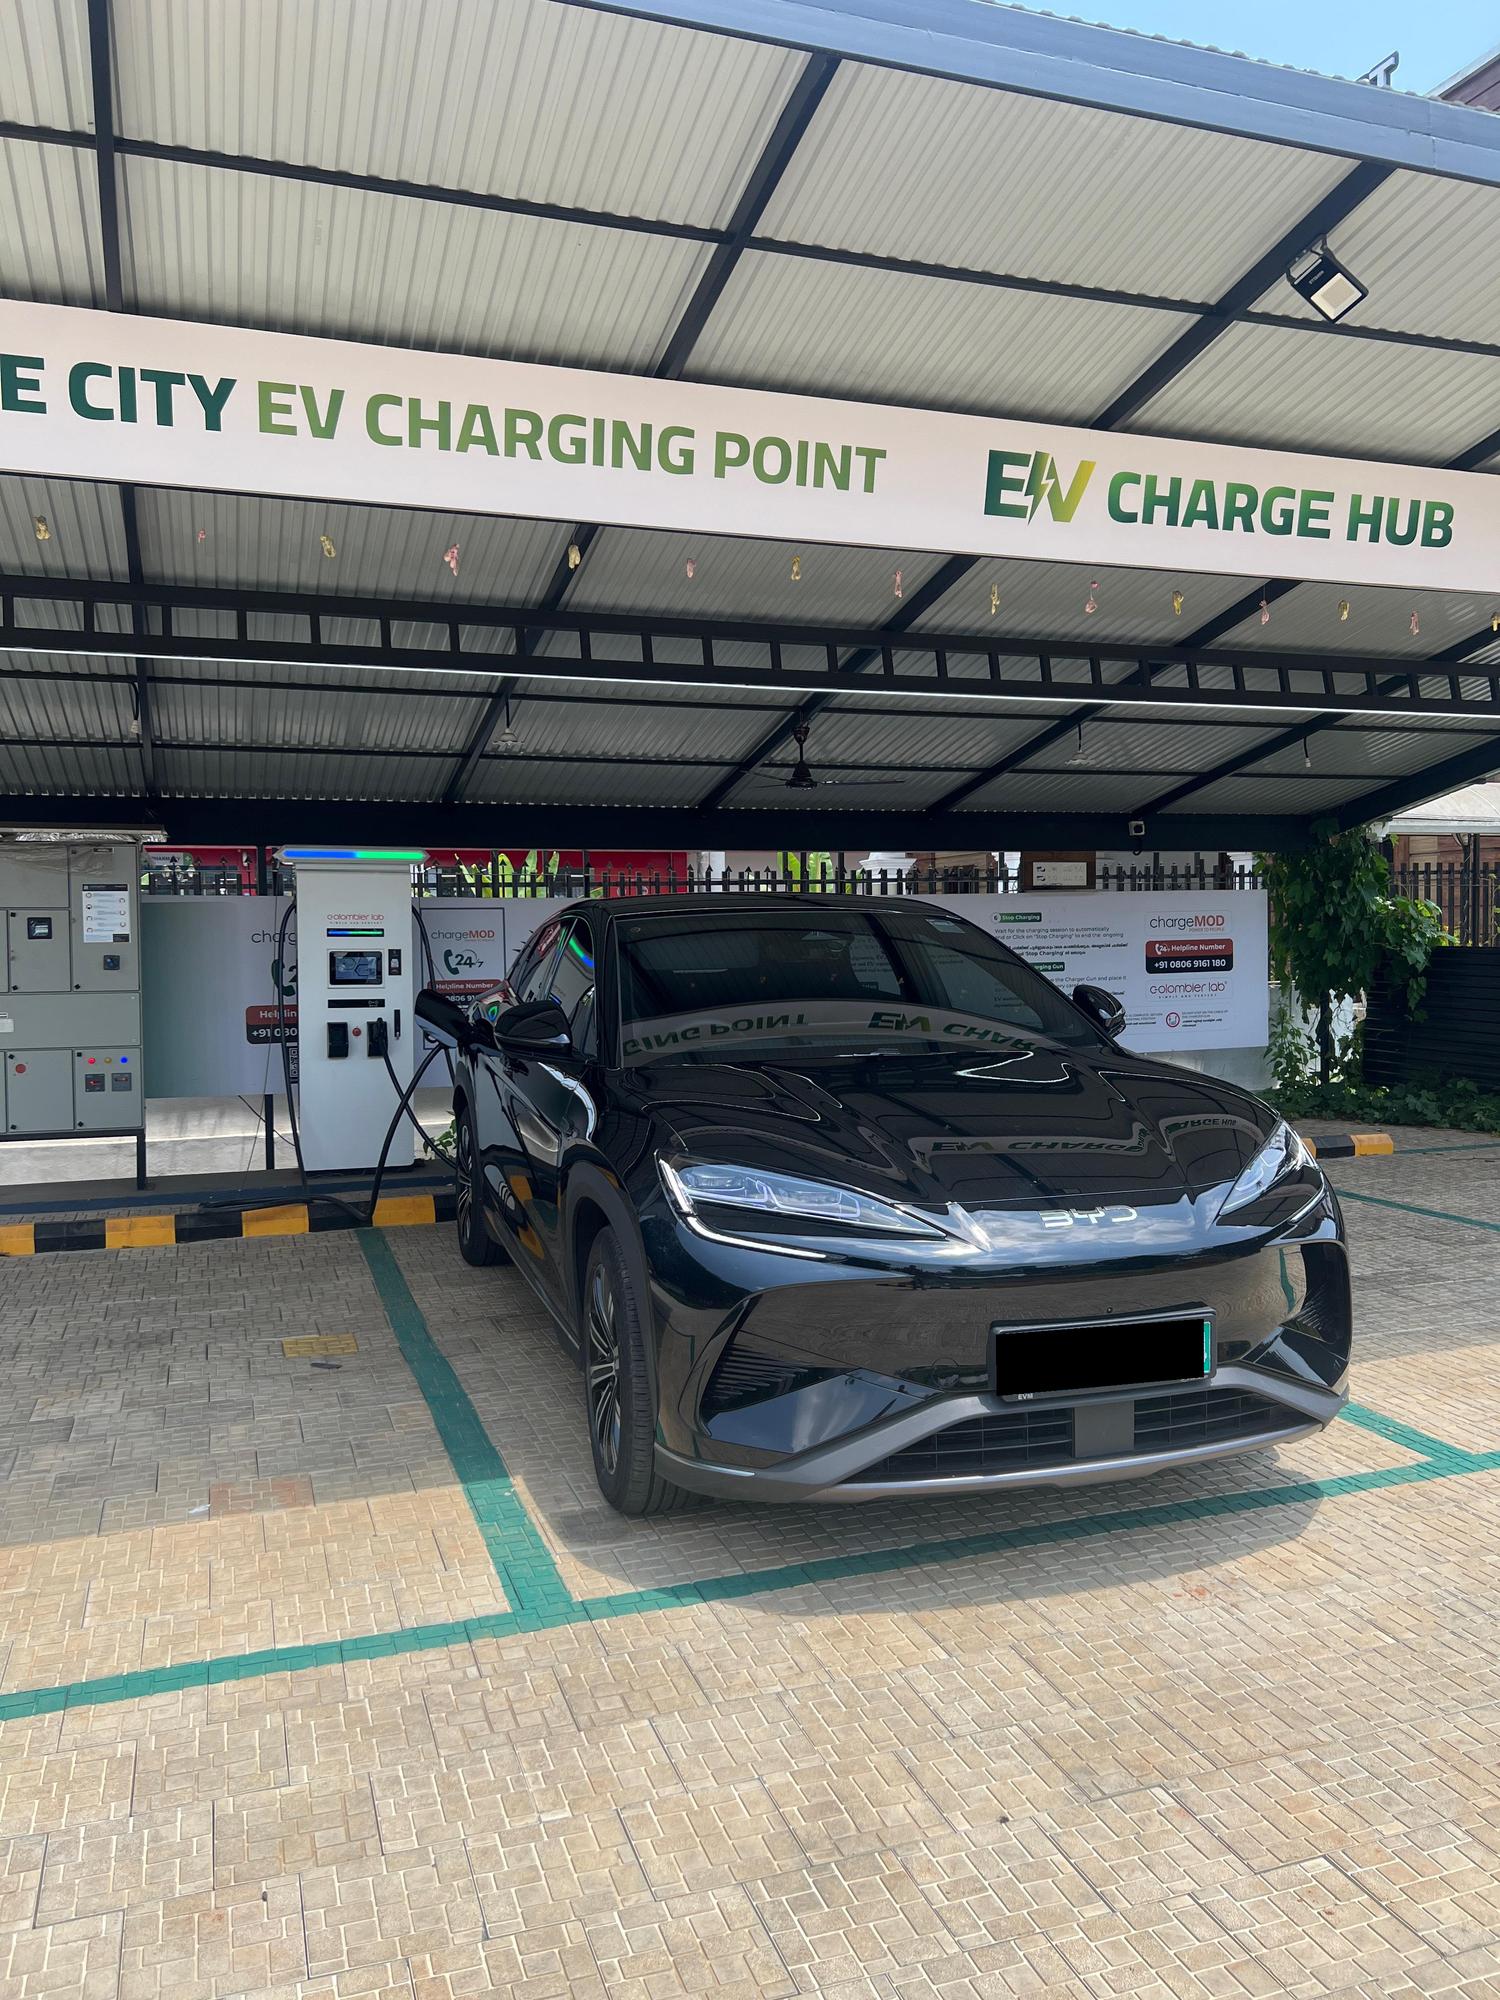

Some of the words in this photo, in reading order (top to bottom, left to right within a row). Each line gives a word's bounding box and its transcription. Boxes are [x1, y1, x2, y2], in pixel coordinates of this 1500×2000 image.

[68, 361, 237, 432] CITY
[257, 380, 345, 440] EV
[365, 394, 695, 475] CHARGING
[714, 431, 887, 494] POINT
[984, 449, 1097, 526] EV
[1108, 471, 1335, 539] CHARGE
[1346, 494, 1454, 548] HUB
[1015, 913, 1040, 921] Charging
[1149, 915, 1225, 931] chargeMOD
[431, 930, 495, 941] chargeMOD
[1172, 944, 1198, 952] Helpline
[1170, 960, 1191, 968] 0806
[1212, 959, 1226, 967] 180
[1150, 984, 1206, 994] colombier
[251, 1028, 271, 1038] +91
[1039, 1205, 1138, 1229] BYD
[1017, 1392, 1034, 1400] EVM
